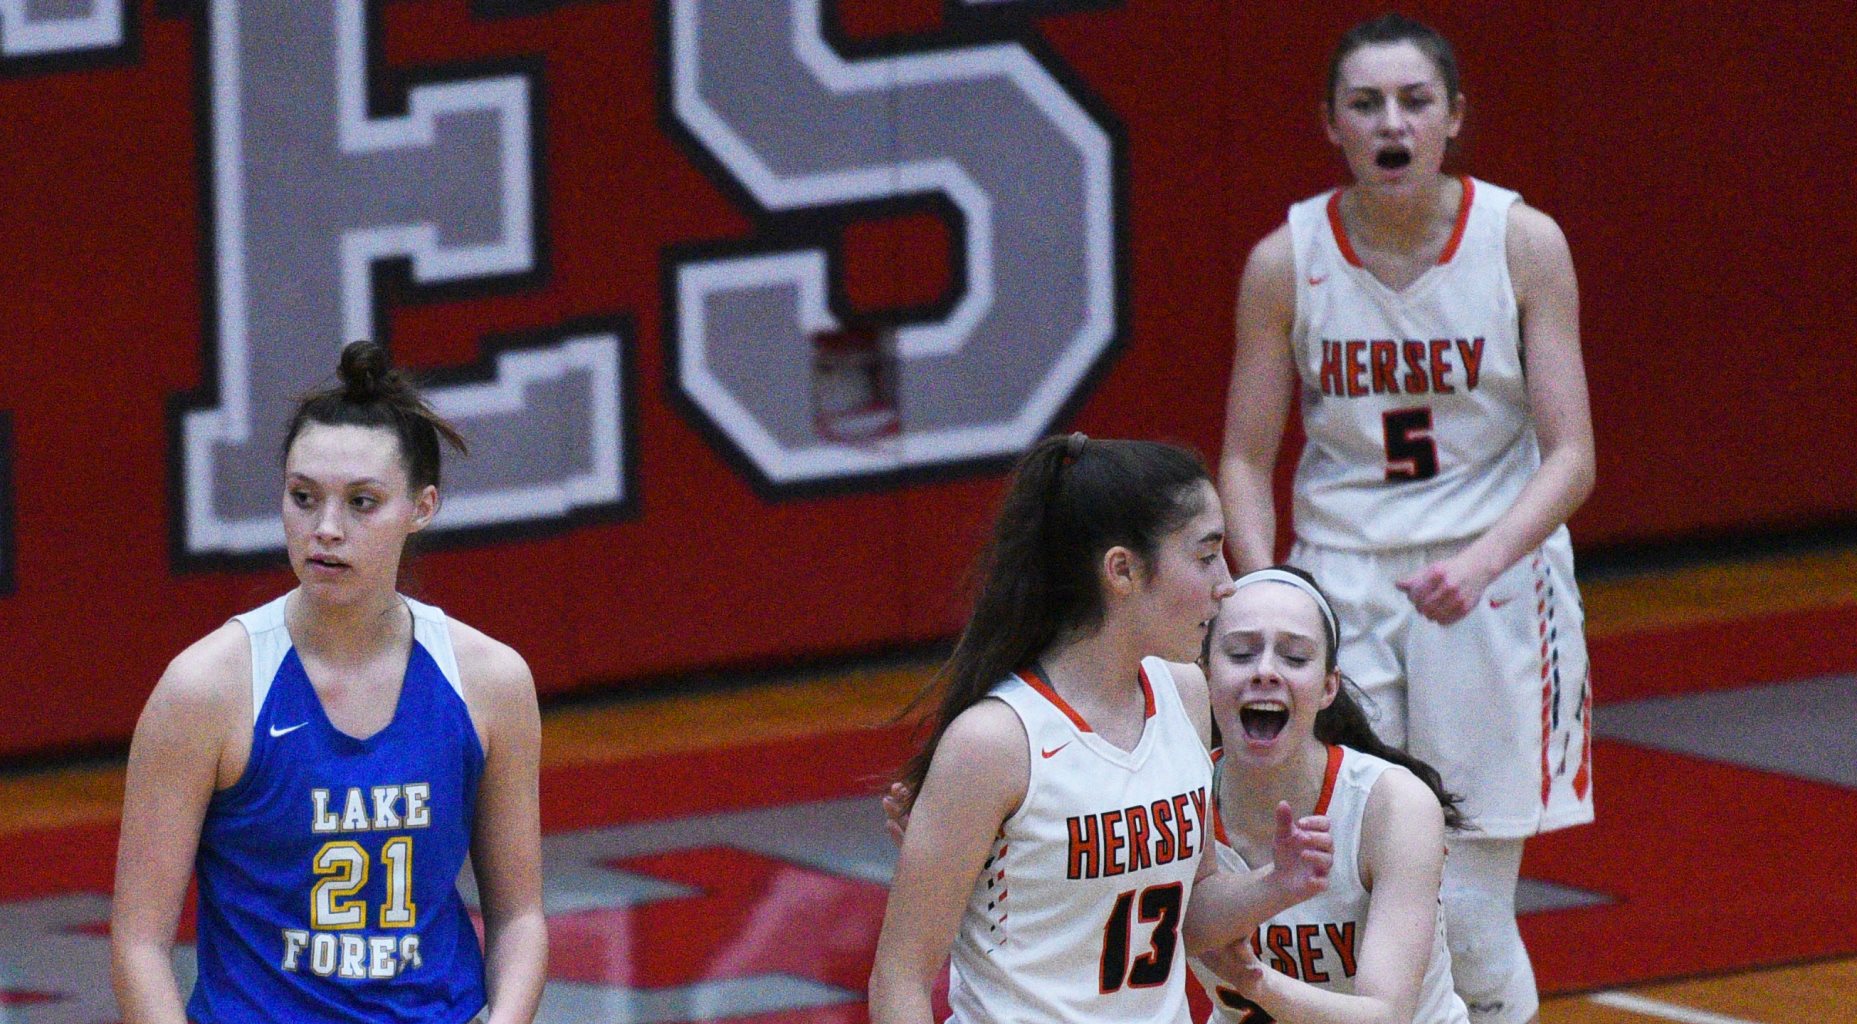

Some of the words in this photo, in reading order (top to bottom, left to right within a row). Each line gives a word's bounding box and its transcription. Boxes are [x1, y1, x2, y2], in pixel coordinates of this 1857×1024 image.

[0, 0, 1124, 560] ES
[1320, 336, 1486, 398] HERSEY
[1382, 405, 1440, 483] 5
[311, 782, 431, 833] LAKE
[1066, 786, 1206, 880] HERSEY
[310, 836, 416, 930] 21
[1100, 880, 1184, 995] 13
[1250, 921, 1358, 983] SEY
